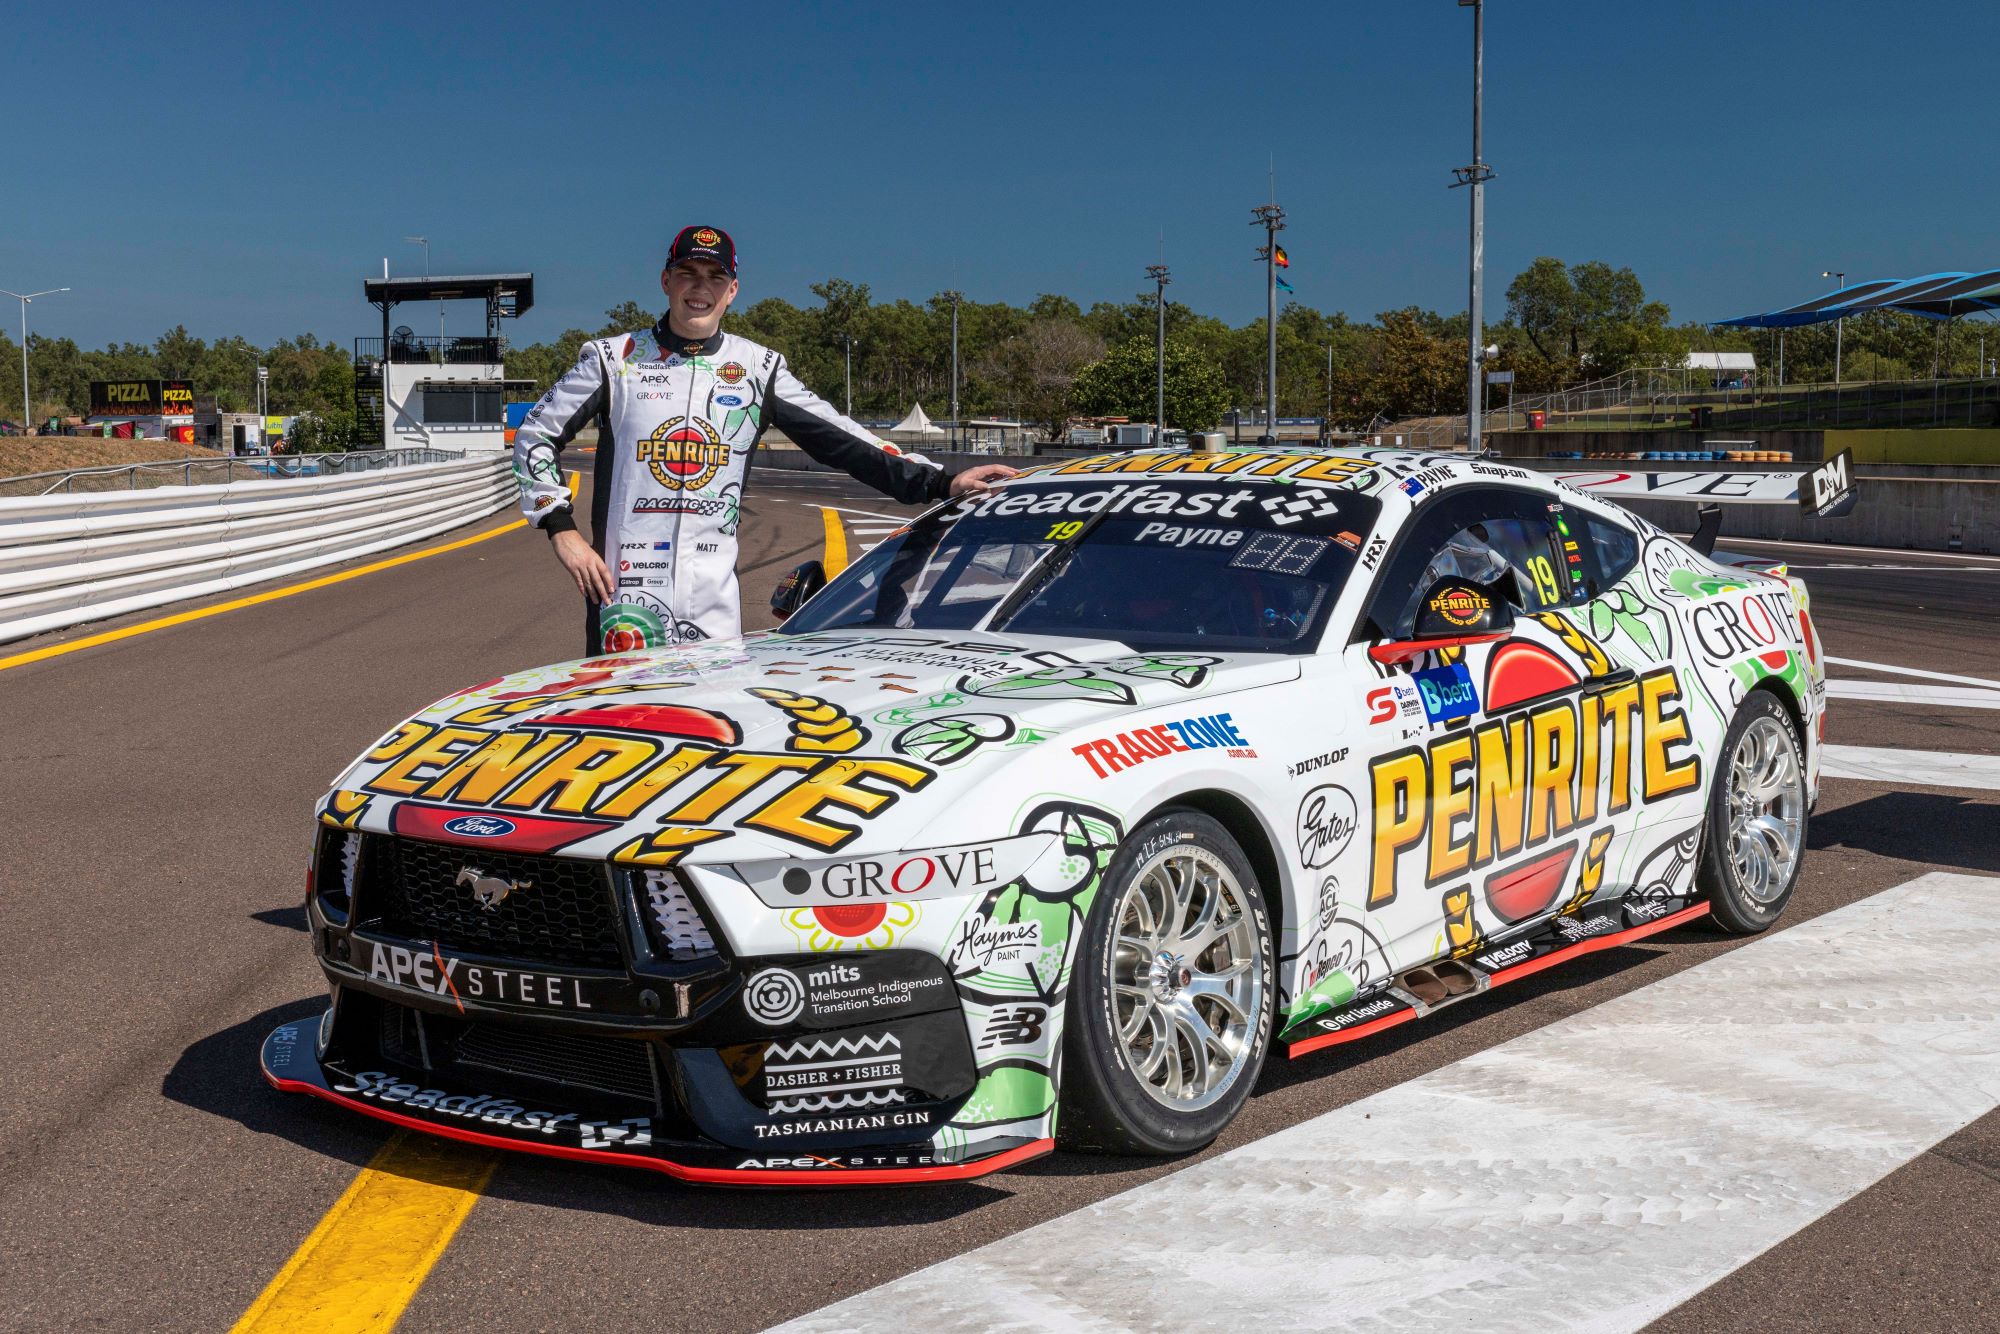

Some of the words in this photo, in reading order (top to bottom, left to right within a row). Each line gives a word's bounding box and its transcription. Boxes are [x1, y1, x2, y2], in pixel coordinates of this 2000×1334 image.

[693, 231, 721, 243] PENRITE
[640, 373, 671, 386] APEX
[716, 368, 746, 377] PENRITE
[107, 383, 150, 402] PIZZA
[163, 389, 193, 401] PIZZA
[636, 391, 672, 400] GROVE
[636, 439, 730, 467] PENRITE
[1004, 452, 1384, 483] PENRITE
[1415, 464, 1458, 488] PAYNE
[1469, 462, 1528, 479] Snap-on
[1811, 453, 1849, 509] D&M
[634, 498, 700, 511] RACING
[938, 484, 1253, 523] Steadfast
[1044, 520, 1084, 541] 19
[1133, 521, 1245, 548] Payne
[620, 542, 648, 550] HRX
[696, 542, 719, 553] MATT
[1362, 533, 1387, 571] HRX
[1526, 555, 1560, 606] 19
[1429, 597, 1491, 611] PENRITE
[1693, 592, 1804, 660] GROVE
[850, 654, 1003, 680] HARDWARE
[852, 648, 1024, 674] ALUMINIUM
[1437, 680, 1474, 707] betr
[1071, 712, 1250, 780] TRADEZONE
[1227, 747, 1258, 760] .com.au
[1295, 746, 1350, 777] DUNLOP
[365, 719, 938, 852] PENRITE
[1367, 665, 1701, 912] PENRITE
[452, 817, 505, 835] Ford
[1301, 795, 1356, 870] Gates
[820, 847, 997, 899] GROVE
[1319, 892, 1340, 917] ACL
[956, 918, 1039, 966] Haymes
[1569, 918, 1618, 942] SPECIALIST
[996, 949, 1022, 962] PAINT
[1490, 939, 1533, 962] VELOCITY
[370, 941, 465, 1015] APEX
[467, 967, 592, 1009] STEEL
[808, 963, 862, 988] mits
[1315, 951, 1344, 981] Repco
[809, 985, 875, 1002] Melbourne
[877, 975, 944, 994] Indigenous
[811, 998, 870, 1015] Transition
[872, 991, 912, 1006] School
[1335, 1010, 1352, 1026] Air
[1352, 998, 1395, 1020] Liquide
[272, 1045, 292, 1068] STEEL
[766, 1071, 829, 1088] DASHER
[832, 1071, 842, 1081] +
[845, 1063, 902, 1081] FISHER
[334, 1071, 580, 1135] Steadfast
[754, 1114, 887, 1138] TASMANIAN
[893, 1111, 931, 1126] GIN
[736, 1154, 847, 1169] APEX
[850, 1155, 954, 1167] STEEL
